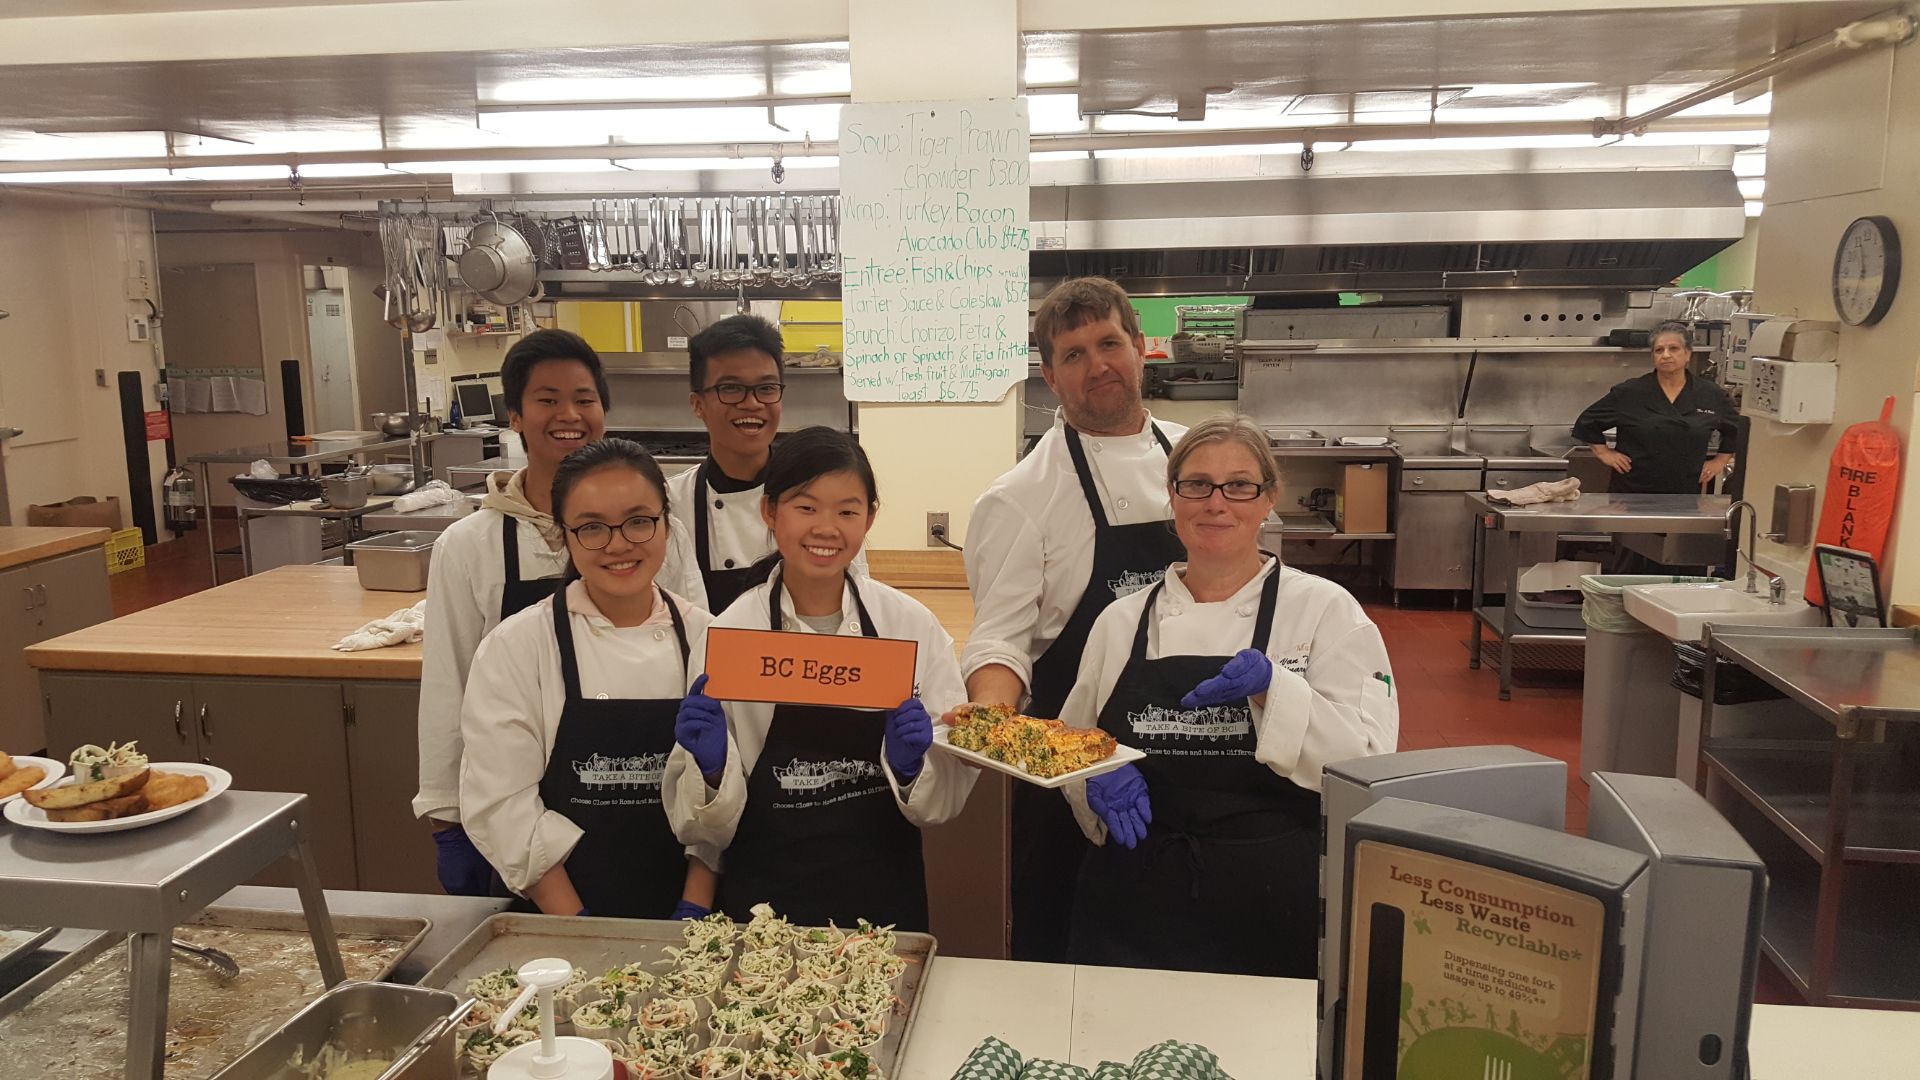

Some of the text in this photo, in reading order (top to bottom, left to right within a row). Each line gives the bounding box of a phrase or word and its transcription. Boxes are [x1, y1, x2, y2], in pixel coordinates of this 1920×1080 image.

[906, 111, 953, 167] Tiger
[960, 109, 1020, 154] Prawn
[904, 155, 979, 189] Chowder
[897, 226, 963, 253] Avocado
[965, 224, 998, 250] Club
[845, 287, 893, 314] Tarter
[949, 282, 1002, 310] Coleslaw
[959, 313, 991, 341] Feta
[995, 314, 1007, 341] &
[845, 345, 890, 371] Spinach
[894, 352, 908, 365] or
[912, 343, 954, 367] Spinach
[958, 344, 969, 364] &
[972, 342, 994, 363] Feta
[848, 370, 882, 388] Served
[901, 365, 924, 382] Fresh
[896, 380, 980, 401] Toast $6.75
[1839, 466, 1878, 485] FIRE
[760, 656, 862, 686] BC Eggs
[1145, 723, 1170, 731] TAKE
[1172, 723, 1180, 731] A
[1182, 724, 1205, 733] BITE
[1206, 725, 1219, 733] OF
[1203, 748, 1220, 756] Make
[592, 772, 662, 781] TAKE A BITE OF
[793, 778, 819, 786] TAKE
[1389, 864, 1576, 928] Less Consumption
[1420, 890, 1531, 933] Less Waste
[1443, 950, 1556, 991] Dispensing one fork
[1443, 961, 1538, 995] at a time reduces
[1443, 971, 1476, 987] usage
[1478, 982, 1493, 994] up
[1495, 986, 1506, 996] to
